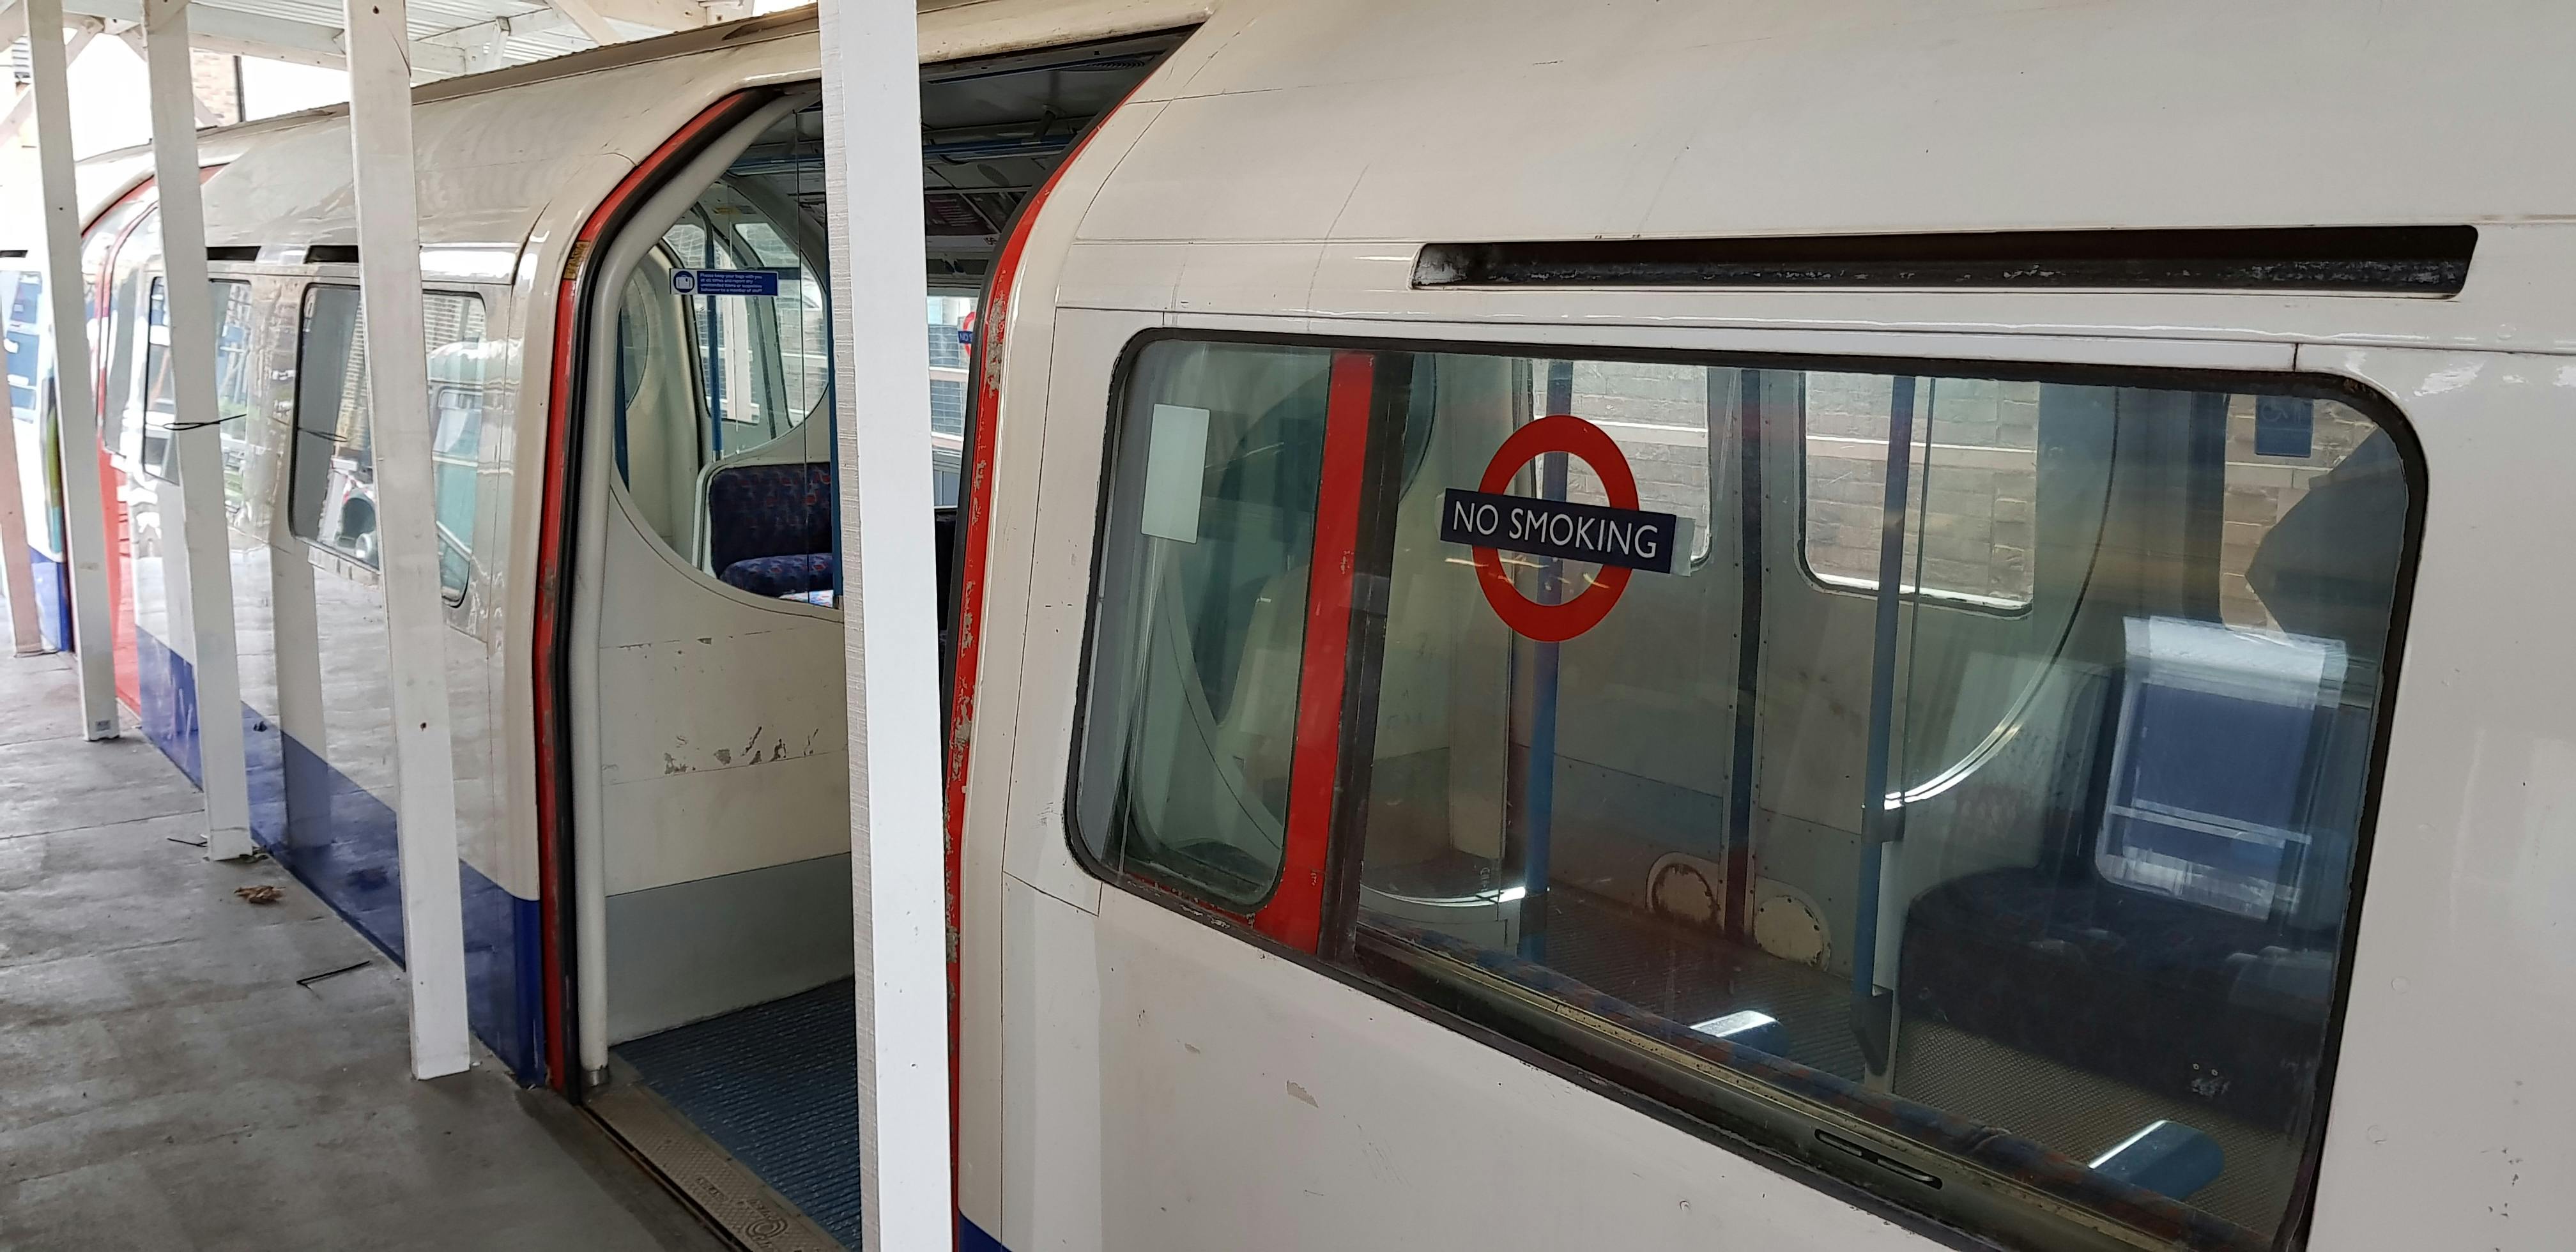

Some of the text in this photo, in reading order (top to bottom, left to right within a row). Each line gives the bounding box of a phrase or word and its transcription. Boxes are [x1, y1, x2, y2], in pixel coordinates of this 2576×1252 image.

[960, 333, 969, 341] NO
[1453, 500, 1659, 559] NO SMOKING
